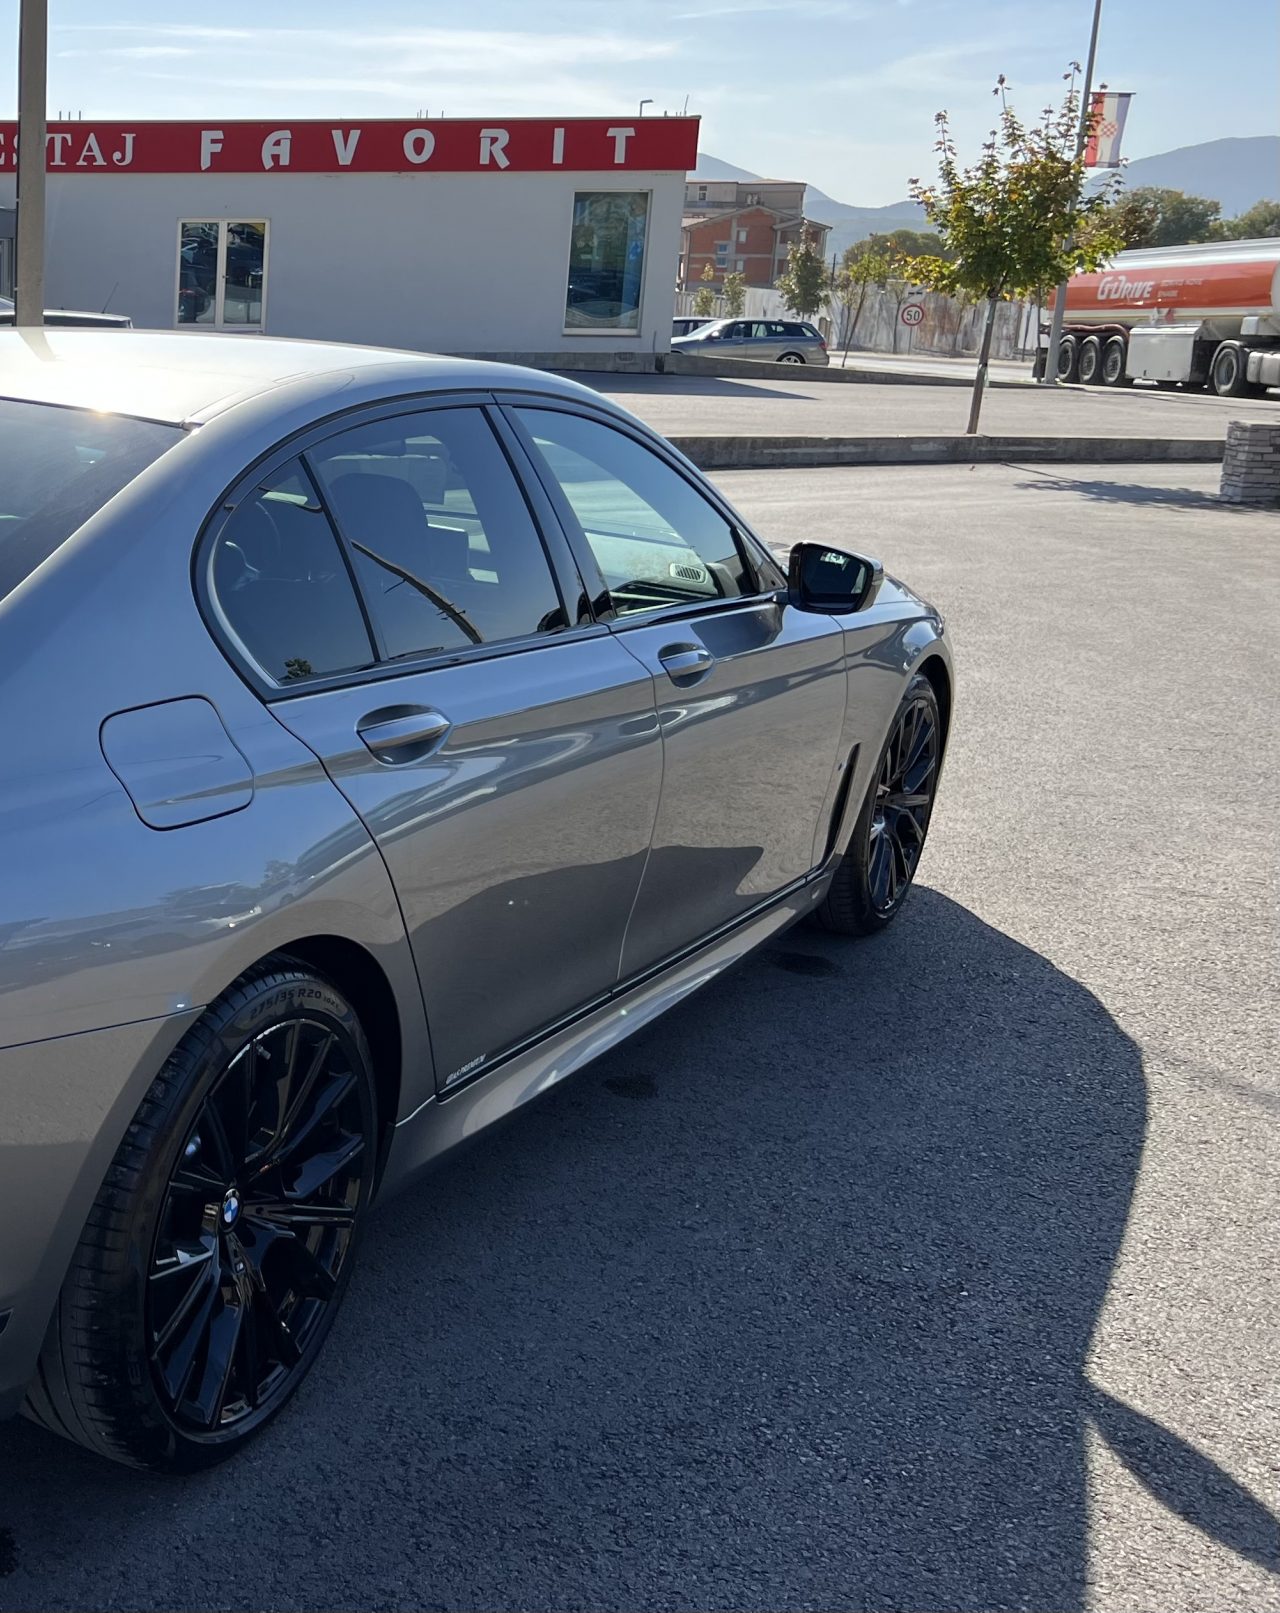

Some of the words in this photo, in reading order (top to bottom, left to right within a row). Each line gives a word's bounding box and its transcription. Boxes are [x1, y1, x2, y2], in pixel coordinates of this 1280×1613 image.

[200, 127, 636, 170] FAVORIT
[906, 310, 920, 321] 50
[249, 988, 294, 1019] 275/35
[298, 988, 322, 999] R20
